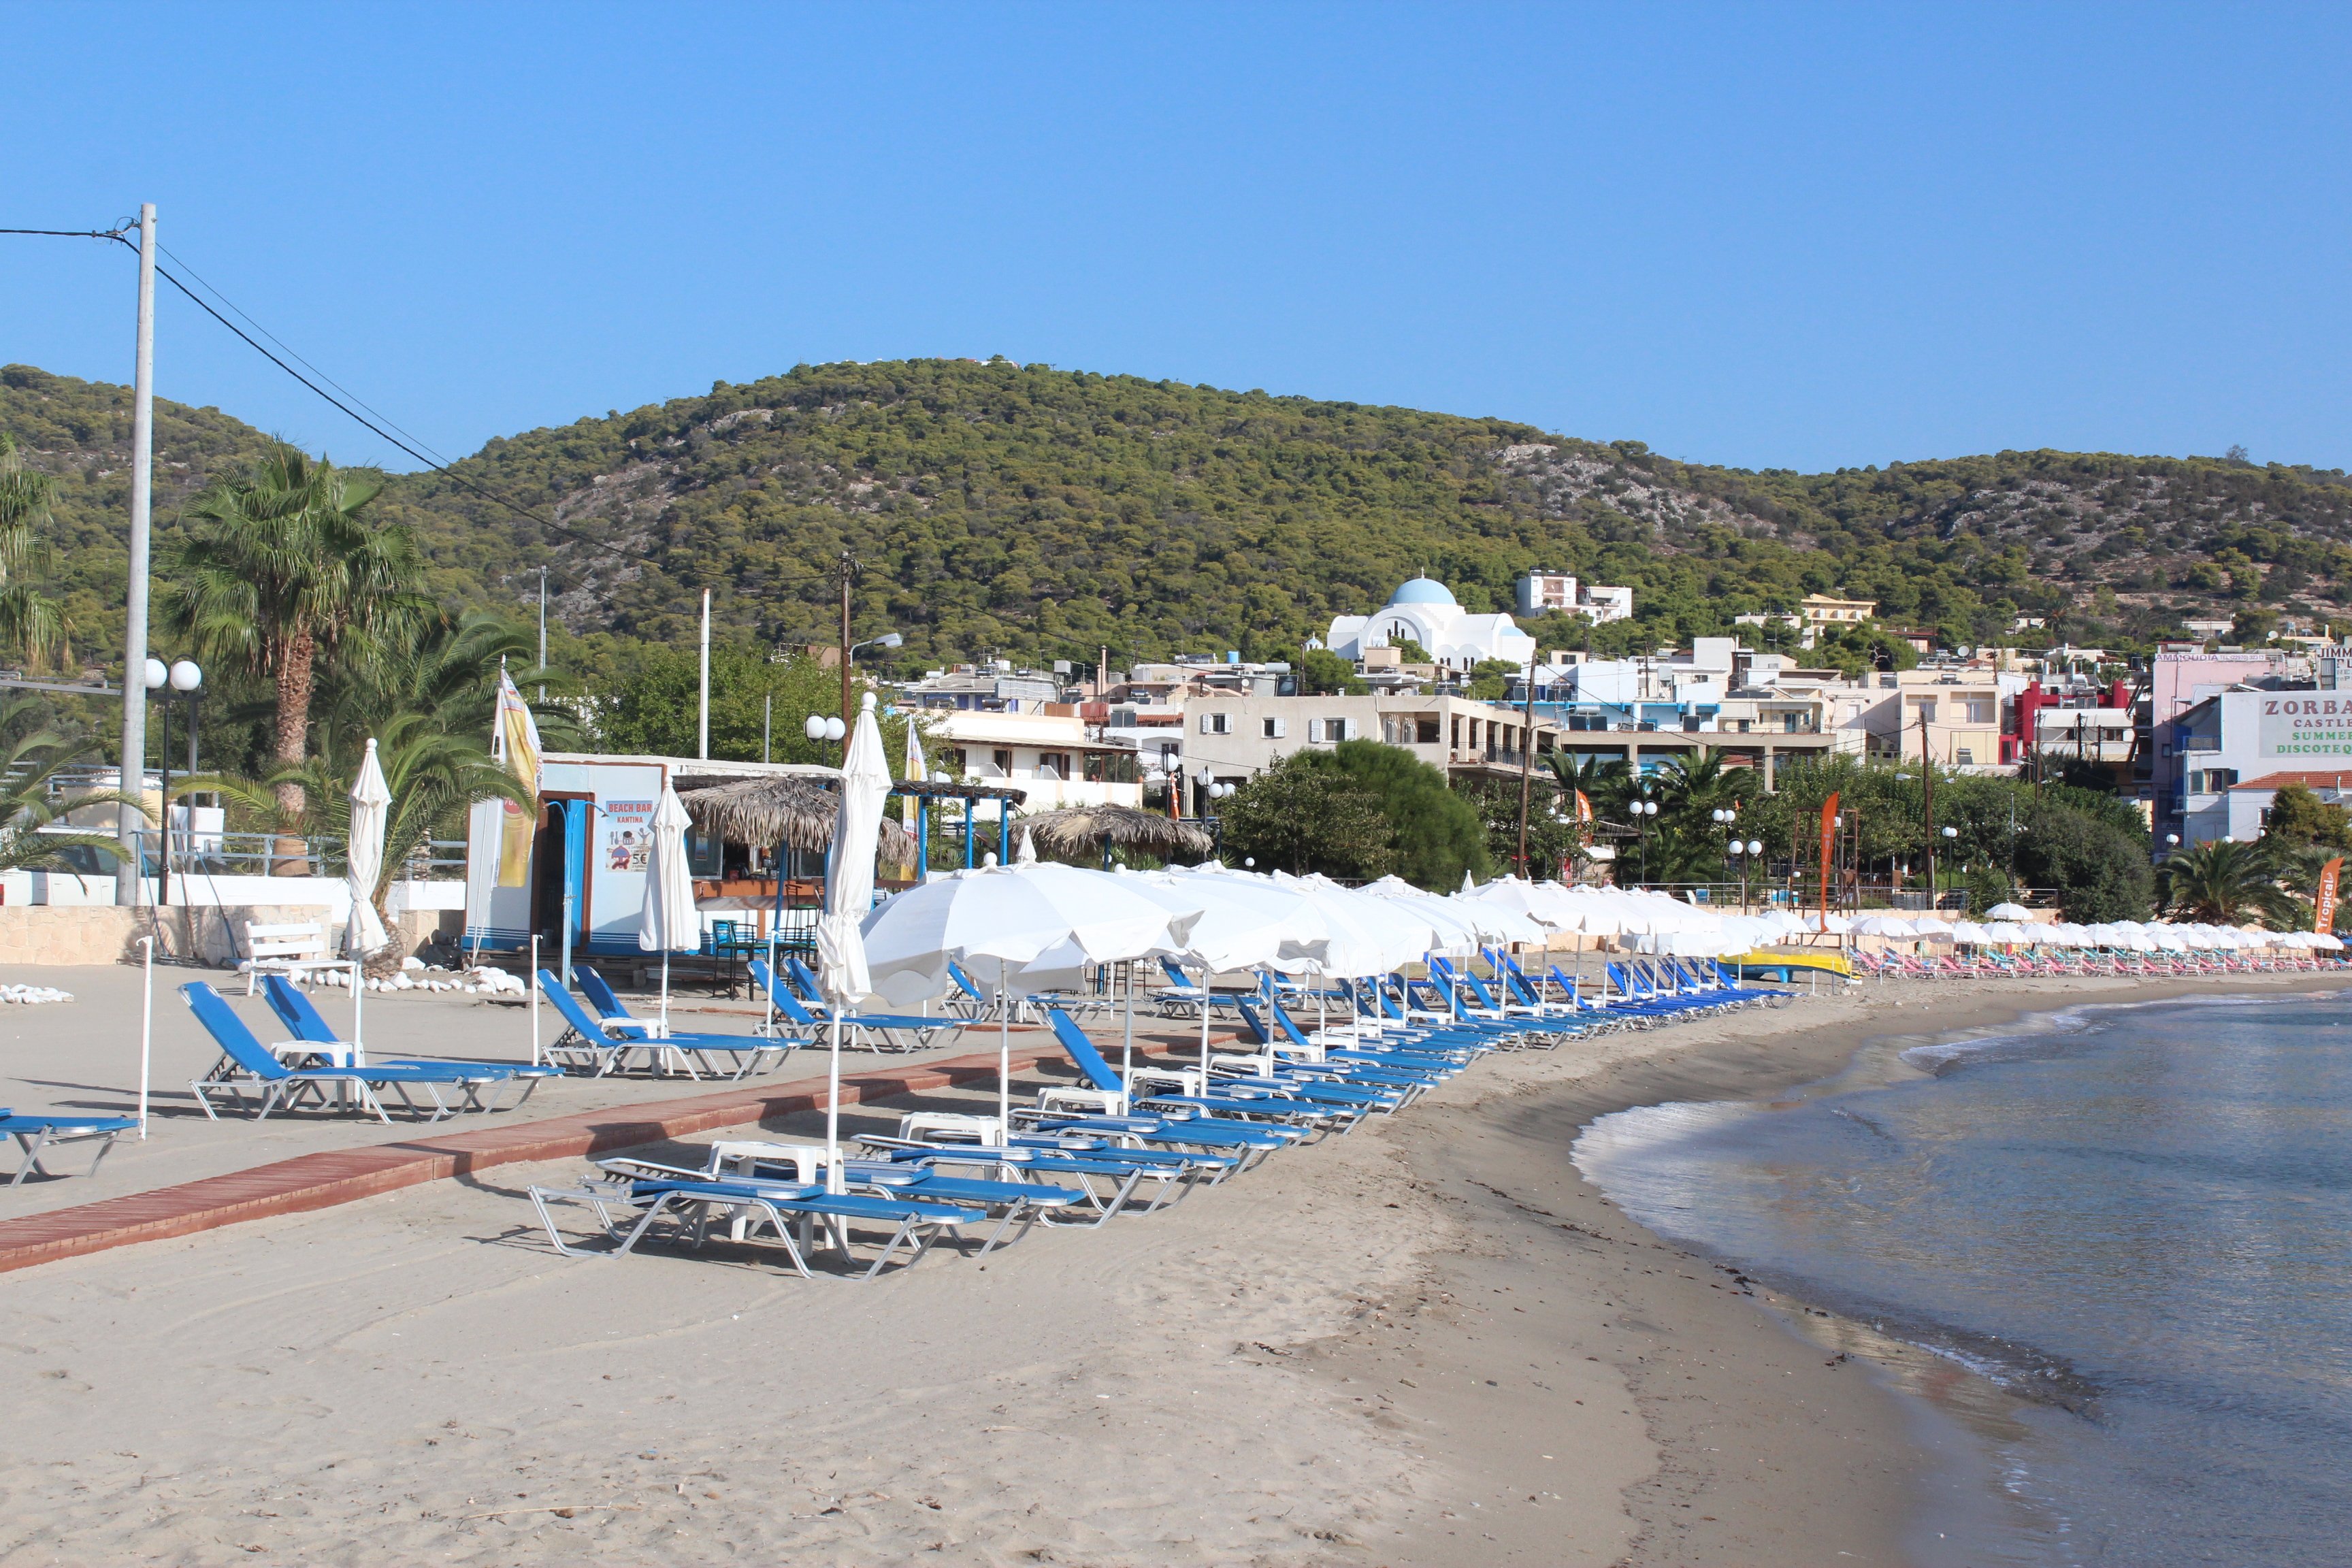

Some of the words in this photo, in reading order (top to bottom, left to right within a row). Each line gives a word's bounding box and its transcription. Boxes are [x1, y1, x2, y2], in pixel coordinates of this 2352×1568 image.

[2265, 700, 2352, 715] ZORBA
[2293, 719, 2352, 728] CASTLE
[2276, 745, 2352, 755] DISCOTEQ
[608, 804, 634, 813] BEACH
[636, 803, 652, 813] BAR
[632, 853, 647, 864] 5€
[2318, 879, 2334, 928] Tropical
